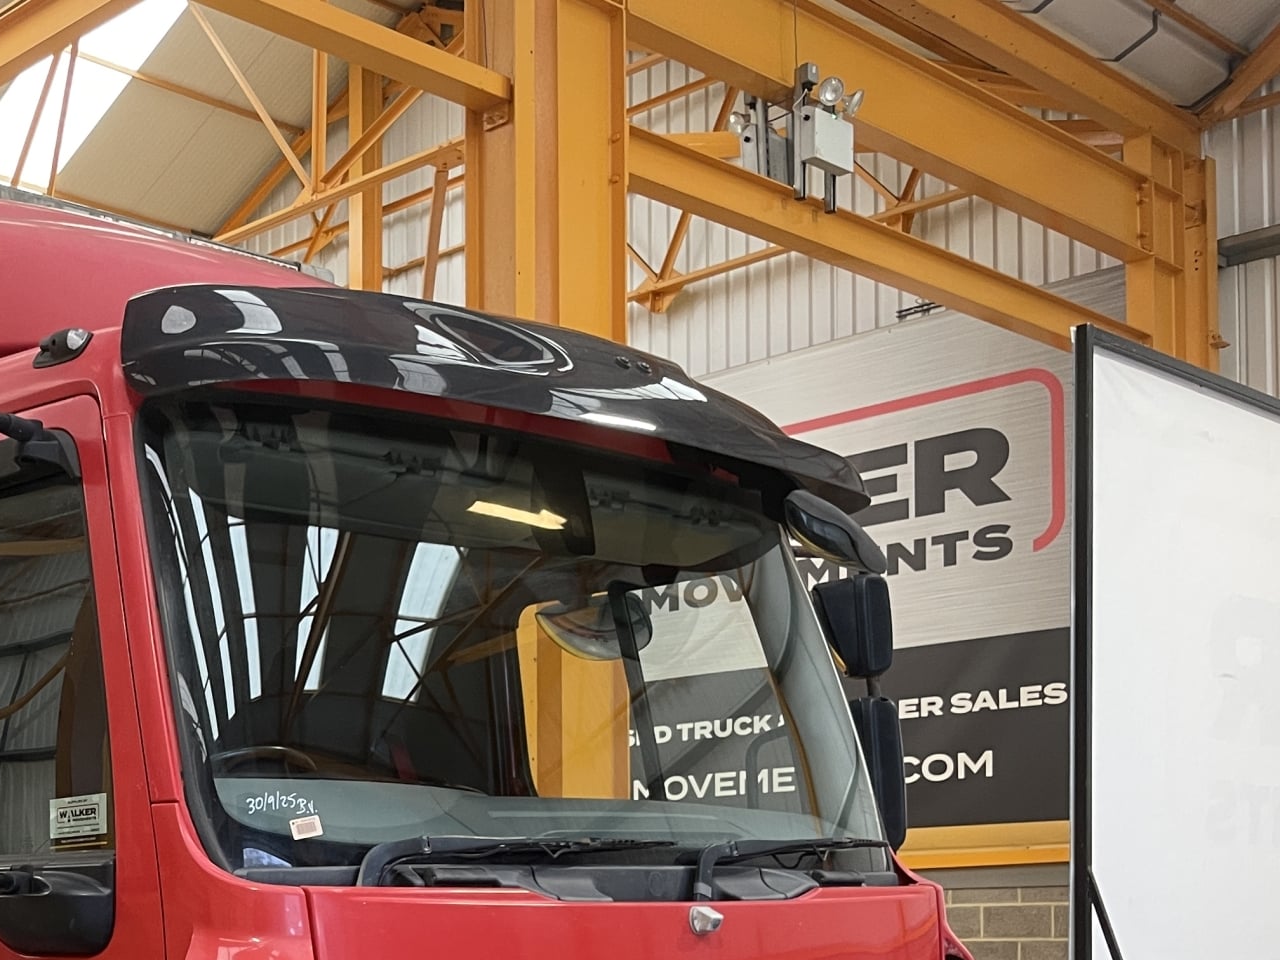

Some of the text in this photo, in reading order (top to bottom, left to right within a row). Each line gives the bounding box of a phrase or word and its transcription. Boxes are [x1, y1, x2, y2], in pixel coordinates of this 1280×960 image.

[676, 714, 773, 742] TRUCK
[950, 682, 1069, 714] SALES
[246, 790, 297, 815] 30/9/25
